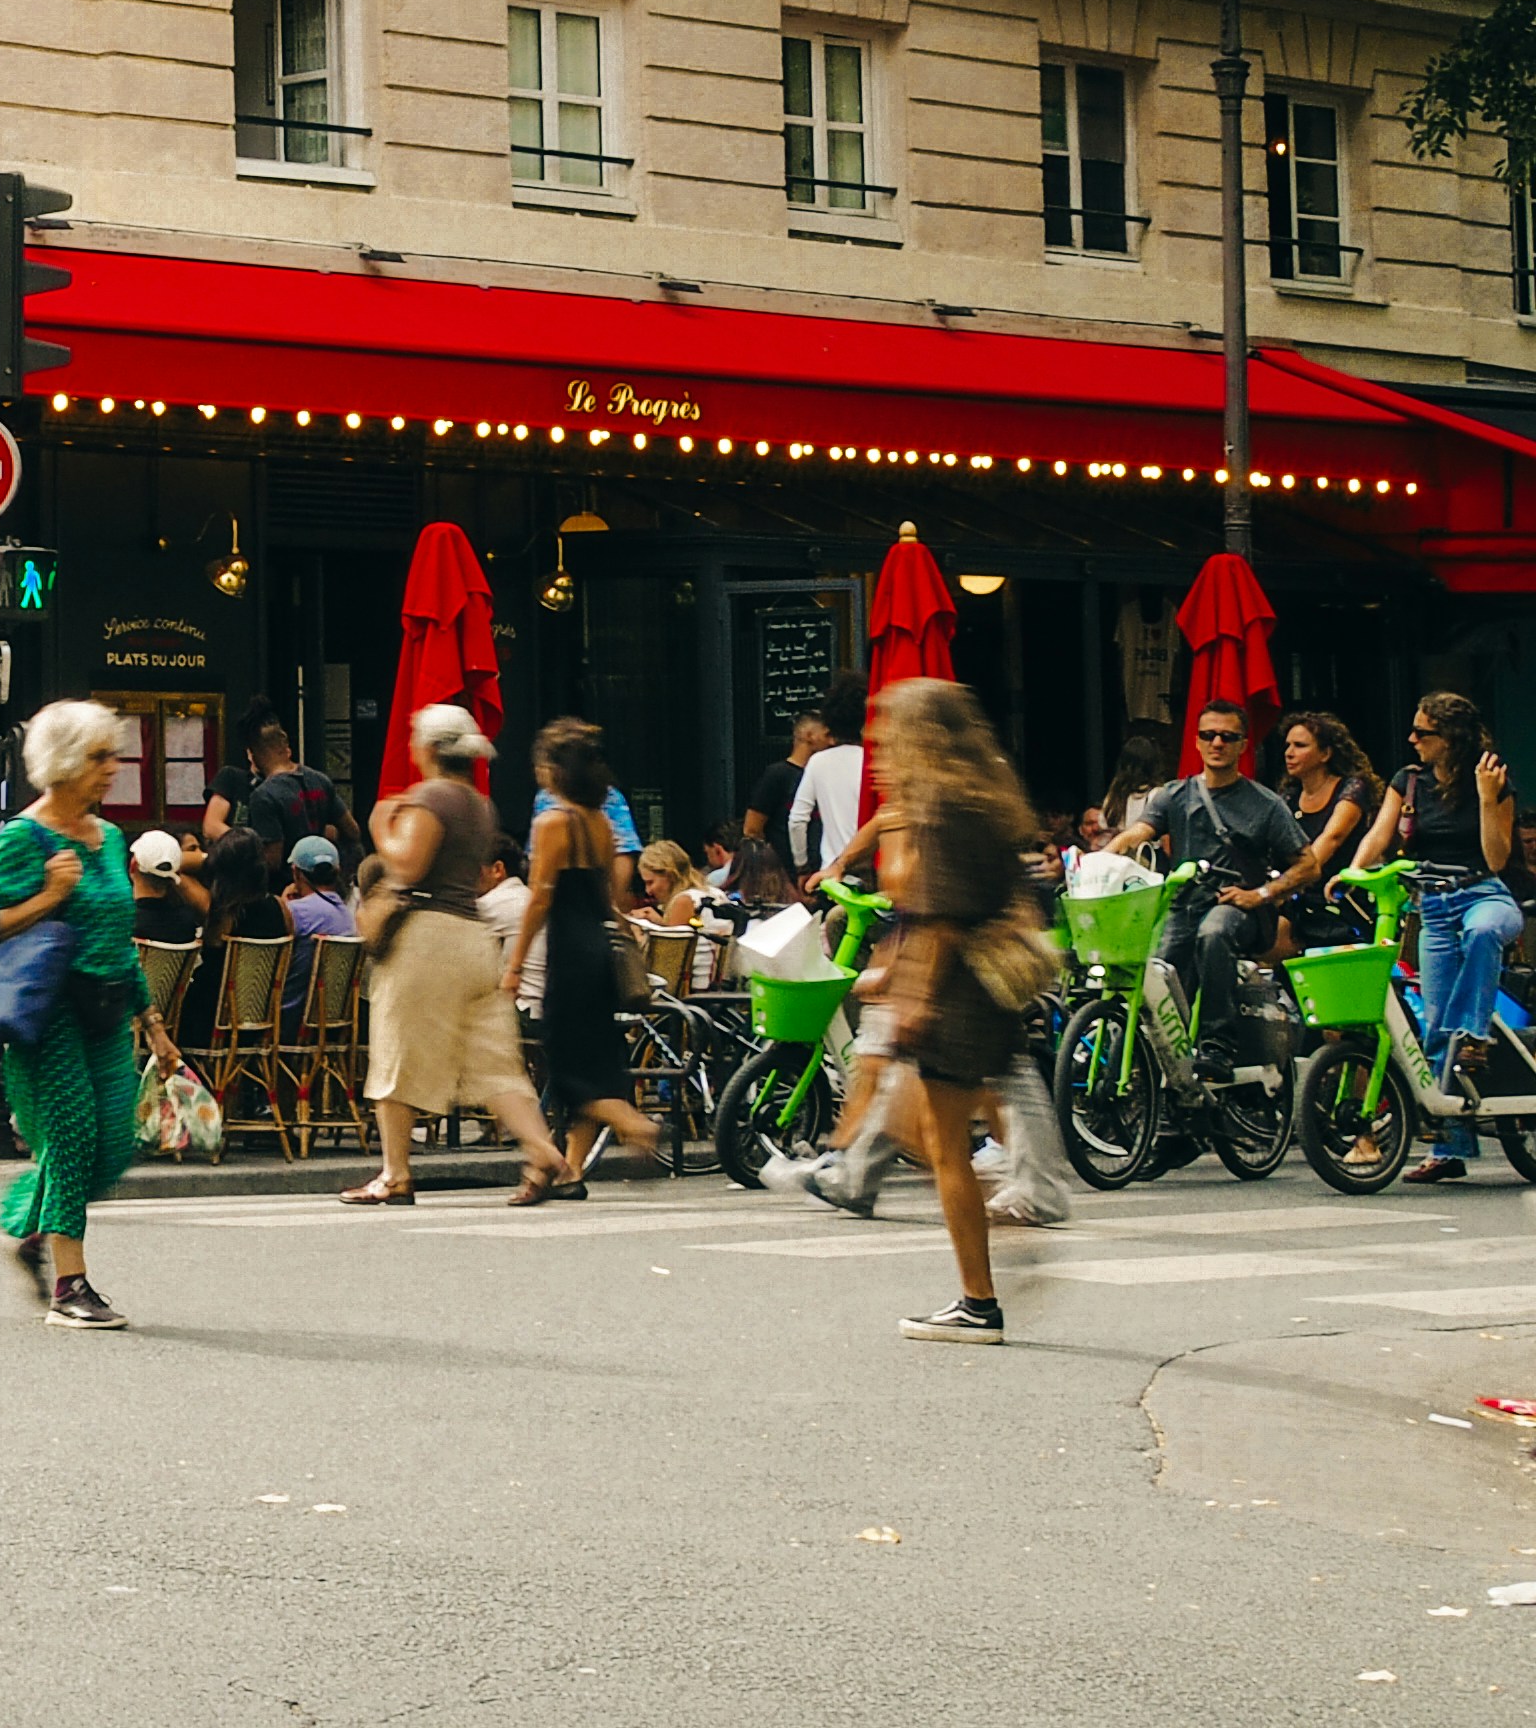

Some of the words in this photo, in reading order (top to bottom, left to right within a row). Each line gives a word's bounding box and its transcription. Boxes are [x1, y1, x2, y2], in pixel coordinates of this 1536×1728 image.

[564, 379, 597, 414] Le
[606, 382, 701, 426] Progrès
[106, 652, 149, 666] PLATS
[151, 654, 168, 667] DU
[169, 653, 207, 668] JOUR
